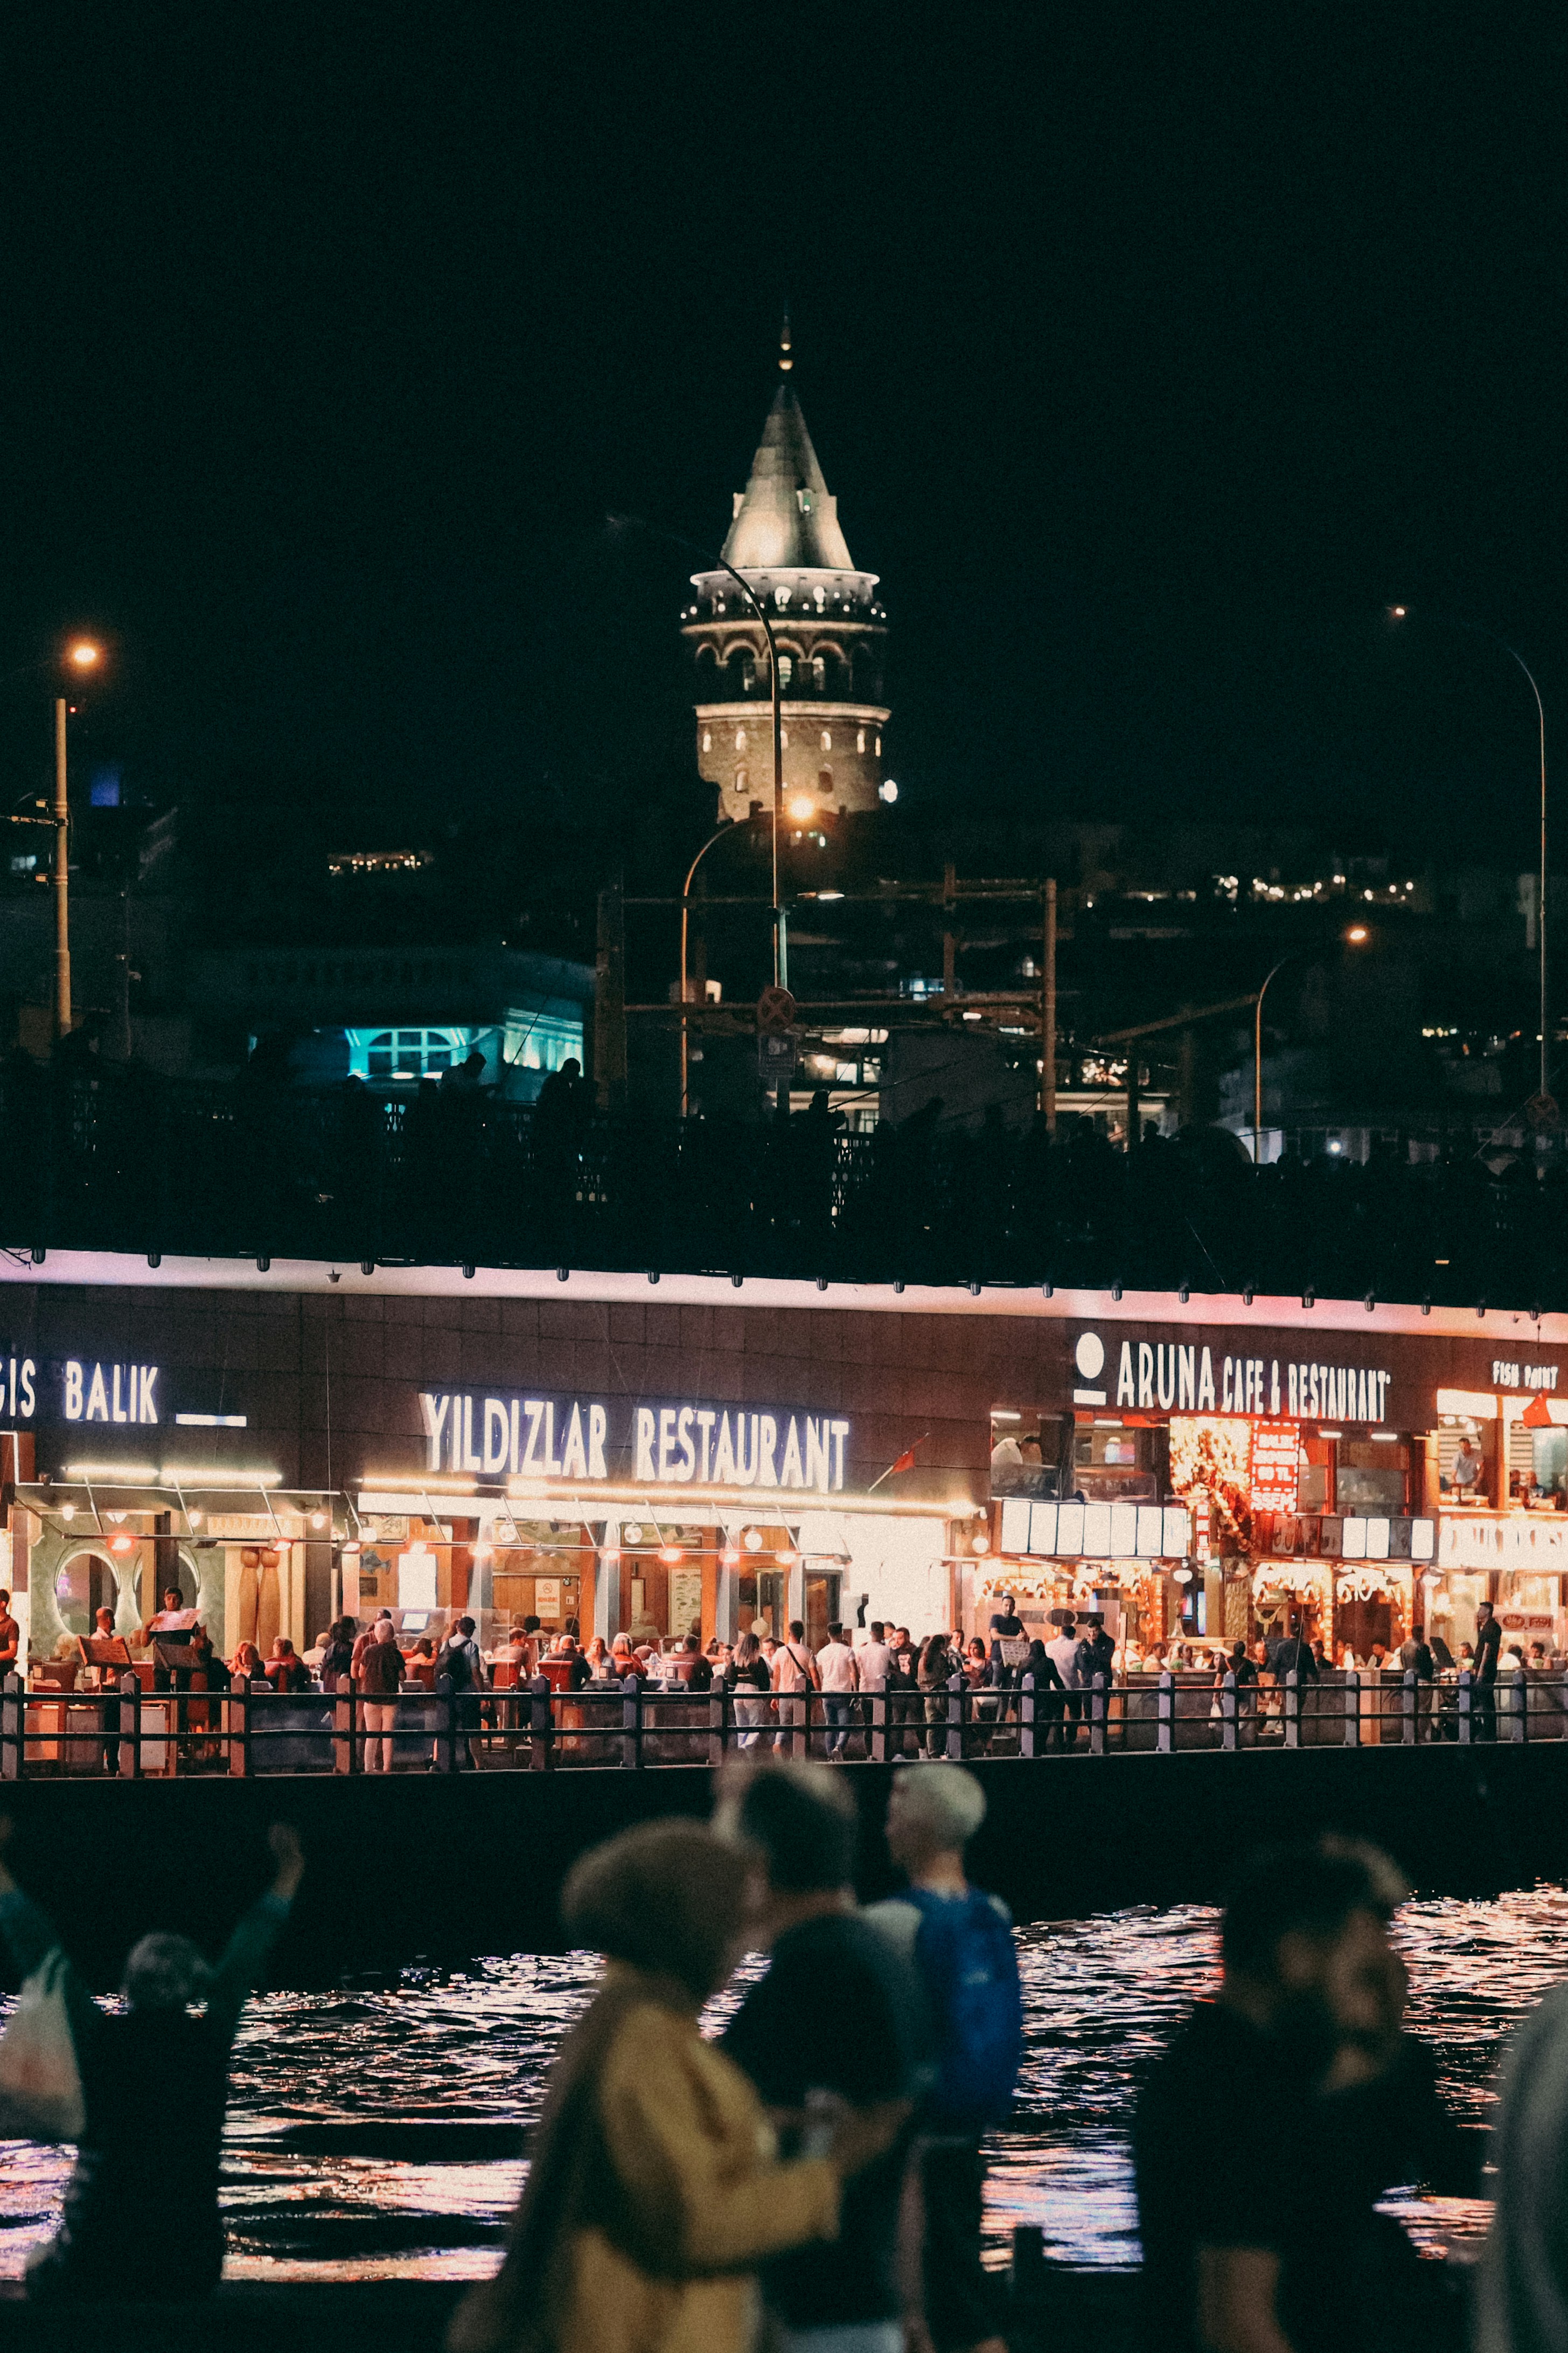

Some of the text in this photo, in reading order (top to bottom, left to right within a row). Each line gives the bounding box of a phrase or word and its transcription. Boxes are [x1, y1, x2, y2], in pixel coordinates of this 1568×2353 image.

[65, 1361, 158, 1424] BALIK
[1117, 1341, 1215, 1411] ARUNA
[1222, 1356, 1264, 1414] CAFE
[1288, 1363, 1386, 1422] RESTAURANT
[1493, 1361, 1558, 1390] FISH POINT
[420, 1393, 849, 1494] YILDIZLAR RESTAURANT
